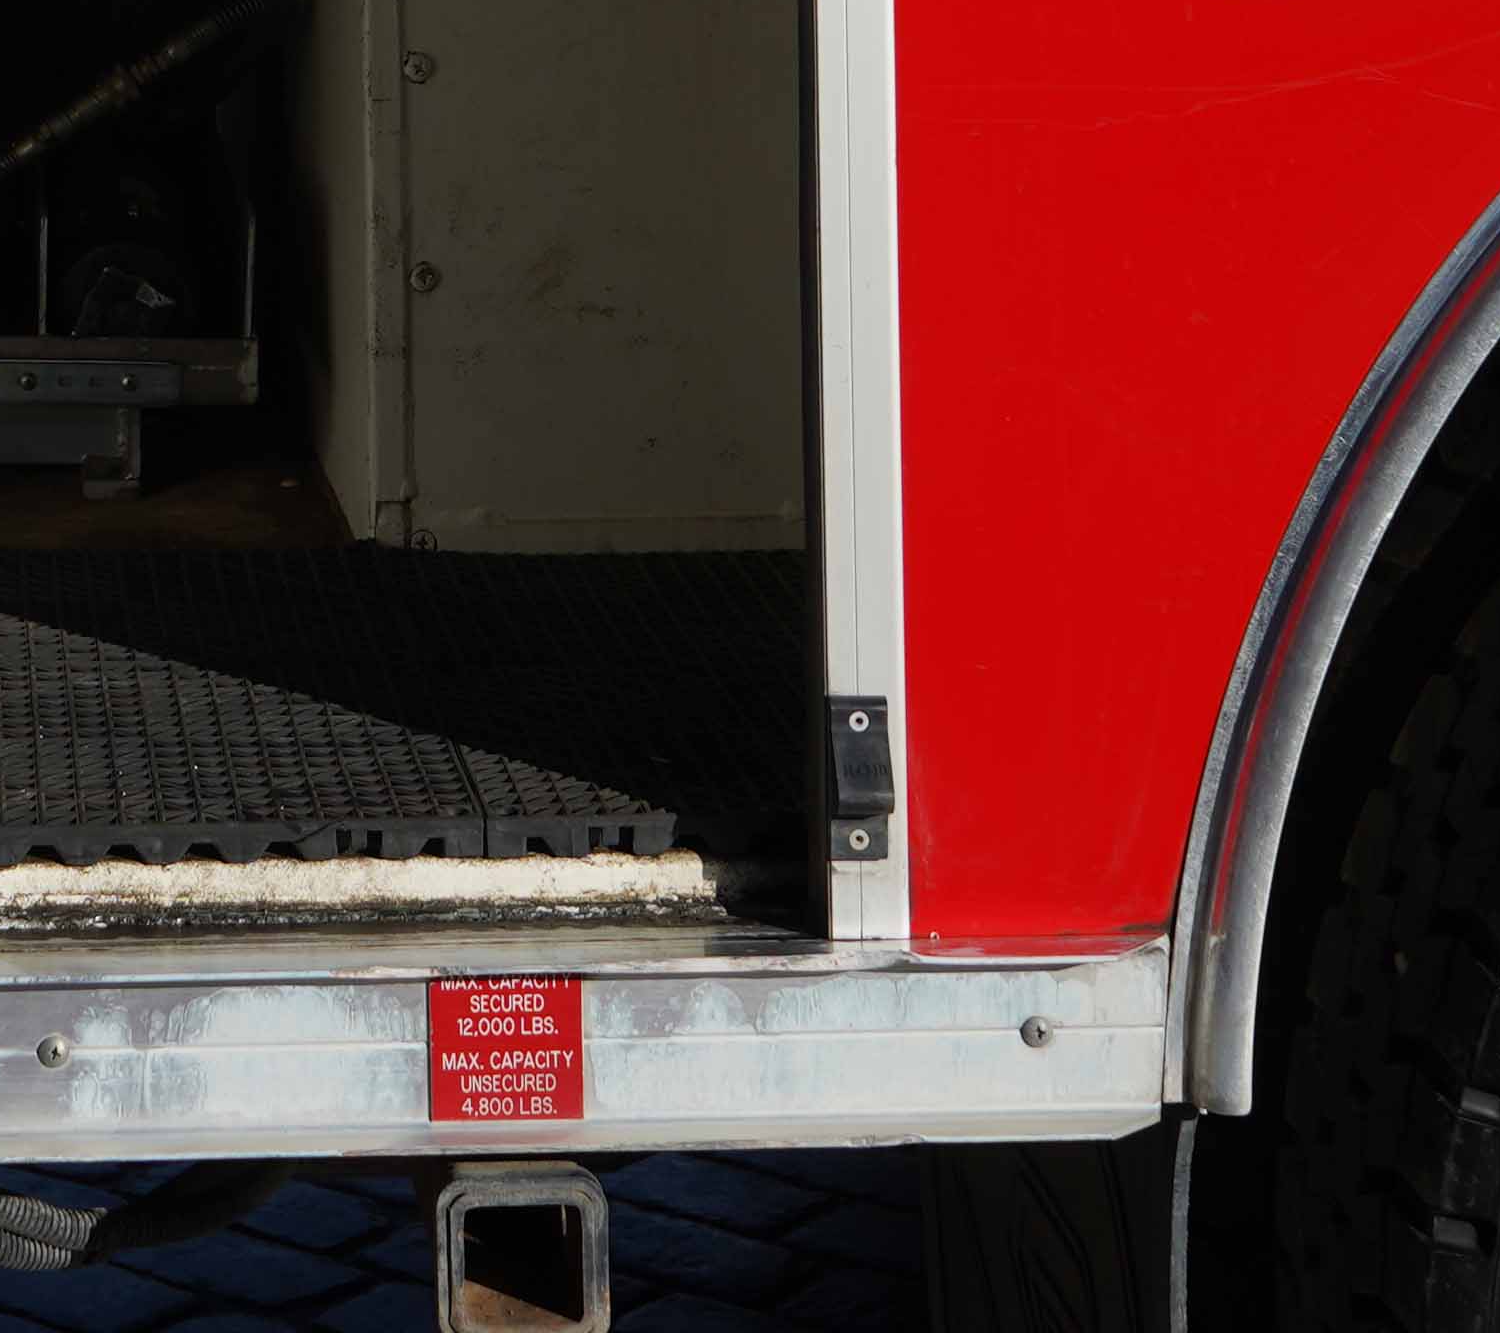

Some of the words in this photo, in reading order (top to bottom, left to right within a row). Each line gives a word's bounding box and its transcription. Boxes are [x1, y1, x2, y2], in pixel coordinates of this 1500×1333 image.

[440, 976, 483, 991] MAX.
[488, 975, 571, 990] CAPACITY
[470, 994, 545, 1013] SECURED
[456, 1017, 515, 1038] 12,000
[520, 1016, 559, 1035] LBS.
[442, 1051, 485, 1071] MAX.
[489, 1050, 574, 1070] CAPACITY
[460, 1074, 557, 1093] UNSECURED
[461, 1097, 515, 1118] 4,800
[519, 1096, 559, 1116] LBS.
